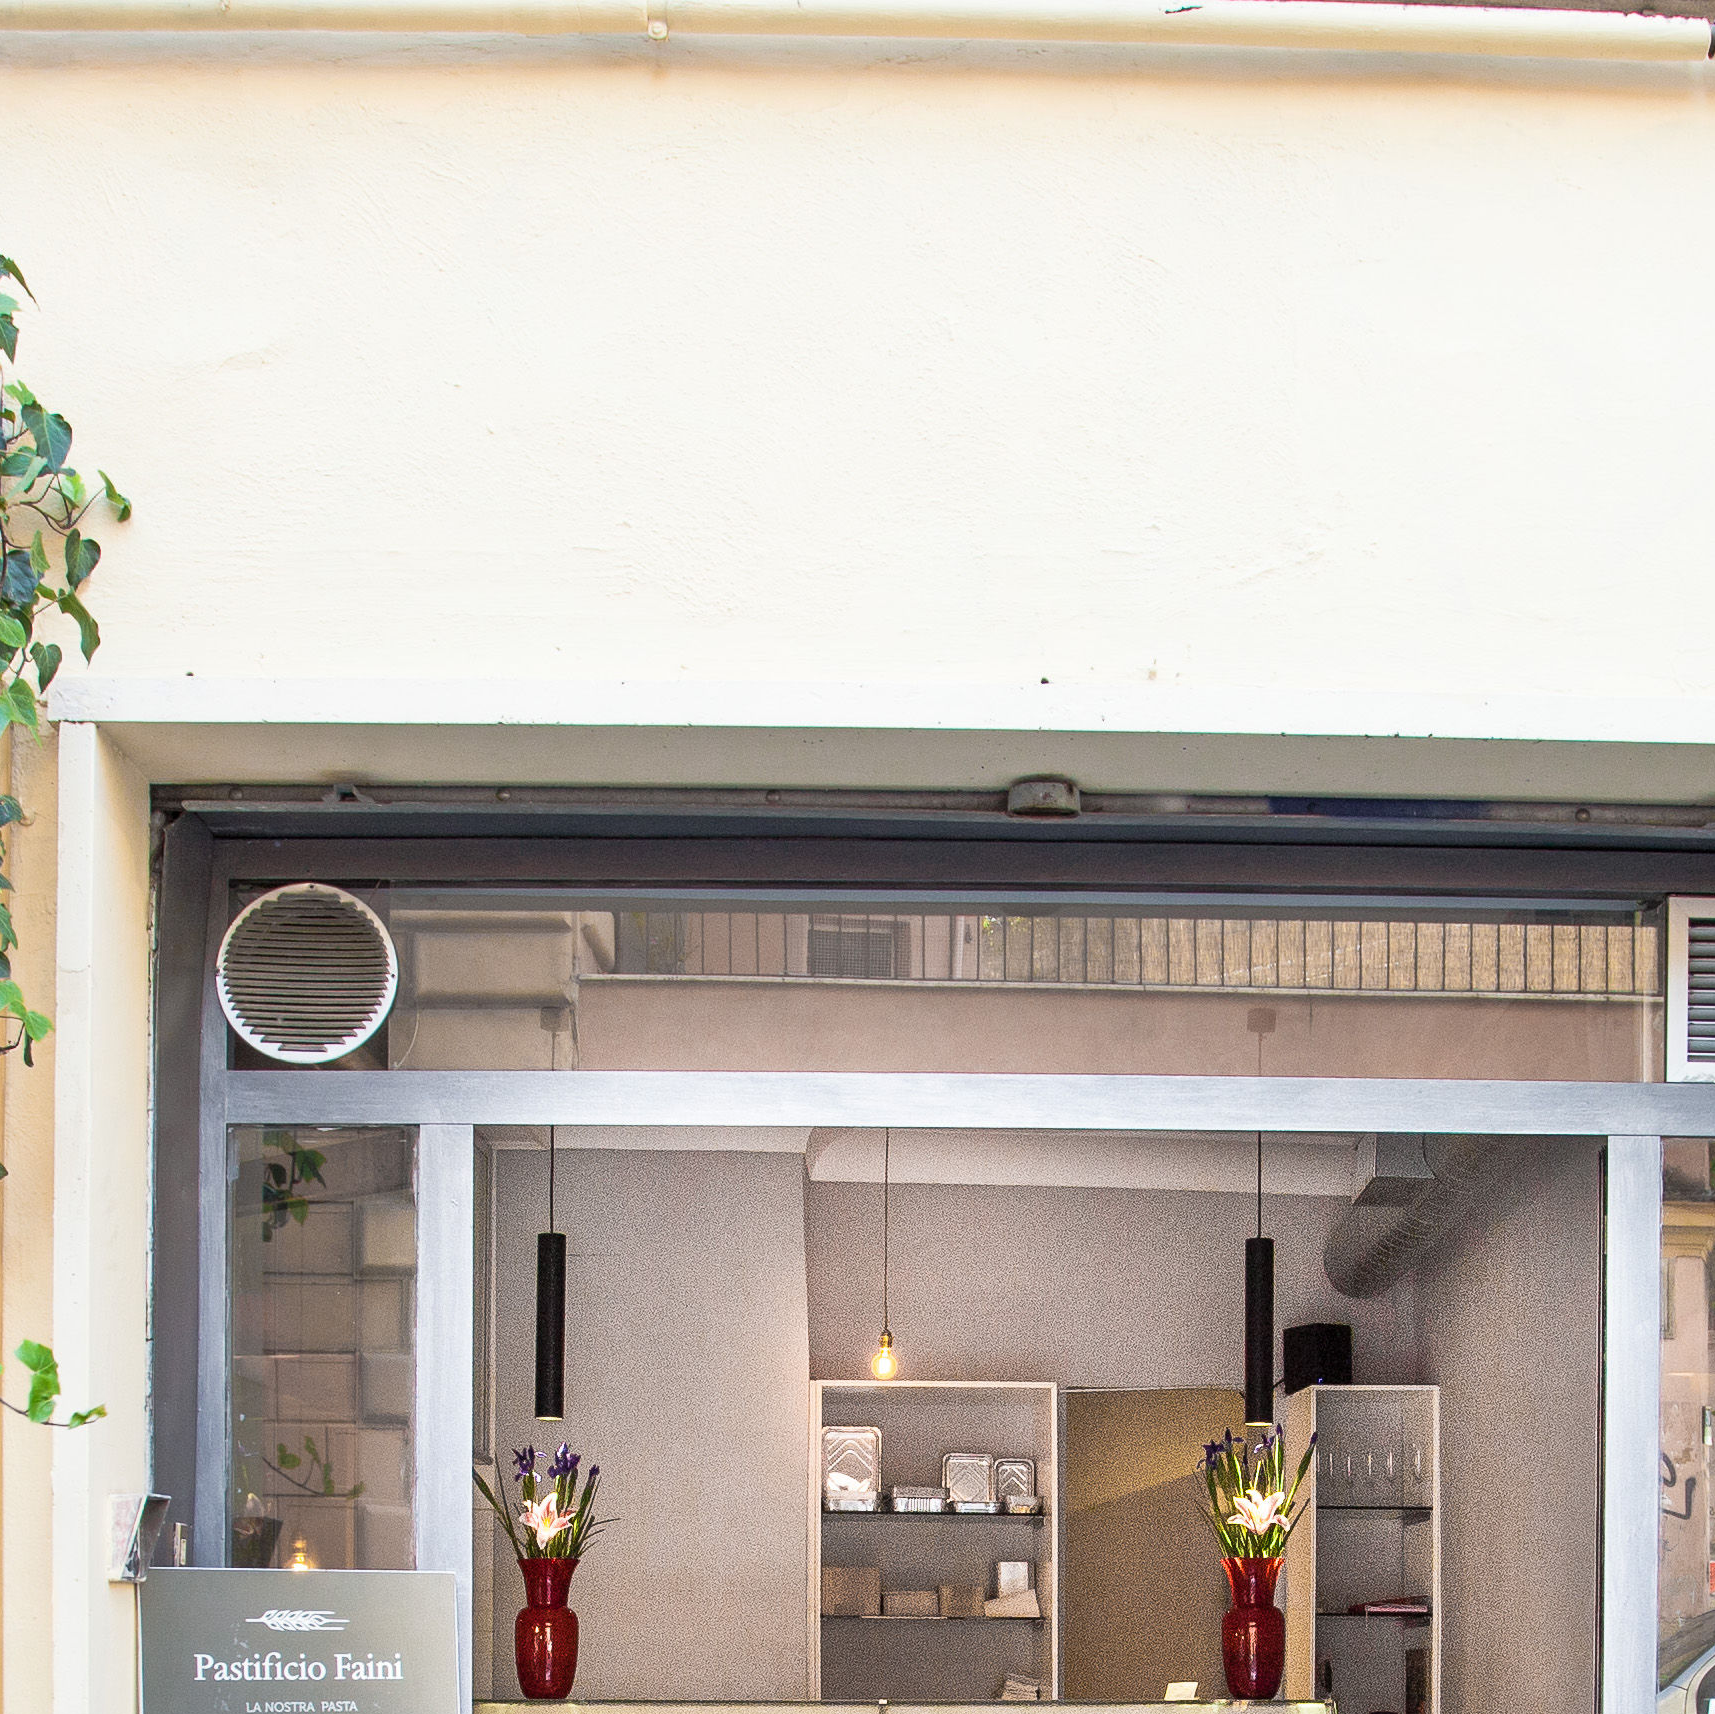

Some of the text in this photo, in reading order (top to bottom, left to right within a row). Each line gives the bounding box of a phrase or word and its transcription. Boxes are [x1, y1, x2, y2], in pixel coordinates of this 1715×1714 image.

[193, 1651, 404, 1682] Pastificio Faini
[245, 1700, 359, 1714] LA NOSTRA PASTA
